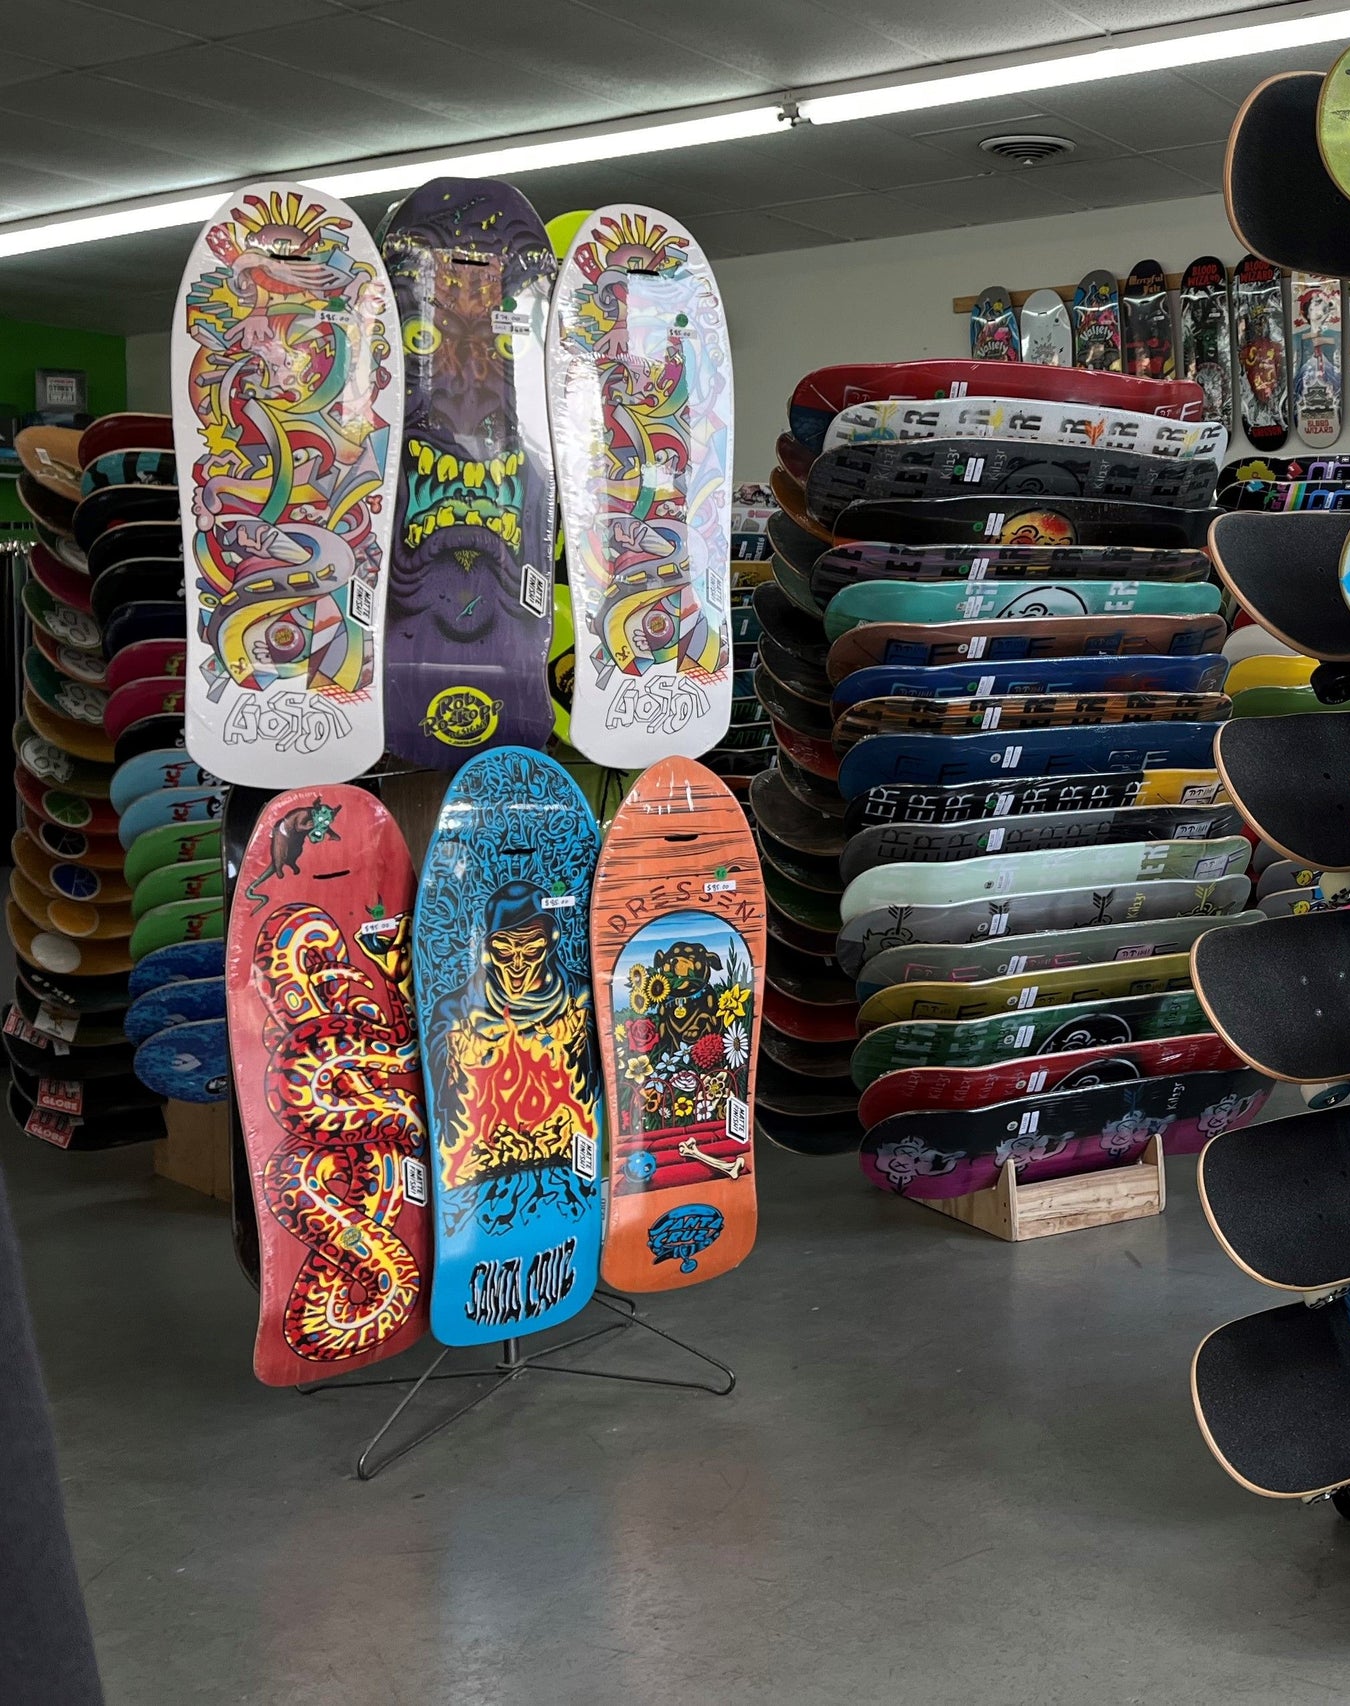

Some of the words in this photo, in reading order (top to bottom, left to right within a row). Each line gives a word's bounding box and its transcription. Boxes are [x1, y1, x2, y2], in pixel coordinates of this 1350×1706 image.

[1188, 274, 1220, 286] WIZARD
[1192, 265, 1217, 276] BLOOD
[1240, 269, 1274, 282] WIZARD
[1304, 425, 1333, 434] WIZARD
[1307, 419, 1329, 427] BLOOD
[363, 590, 371, 619] MATTE
[535, 577, 544, 612] MATTE
[440, 692, 476, 717] Rob
[418, 699, 504, 737] Roskopp
[608, 881, 755, 933] DRESSEN
[41, 1096, 78, 1112] GLOBE
[31, 1123, 65, 1143] GLOBE
[738, 1109, 746, 1136] MATTE
[585, 1144, 593, 1172] MATTE
[416, 1166, 424, 1197] MATTE
[650, 1216, 723, 1236] SANTA
[465, 1256, 522, 1326] SANTA
[525, 1235, 577, 1319] CRUZ
[302, 1290, 352, 1349] SANTA
[358, 1287, 415, 1347] CRUZ
